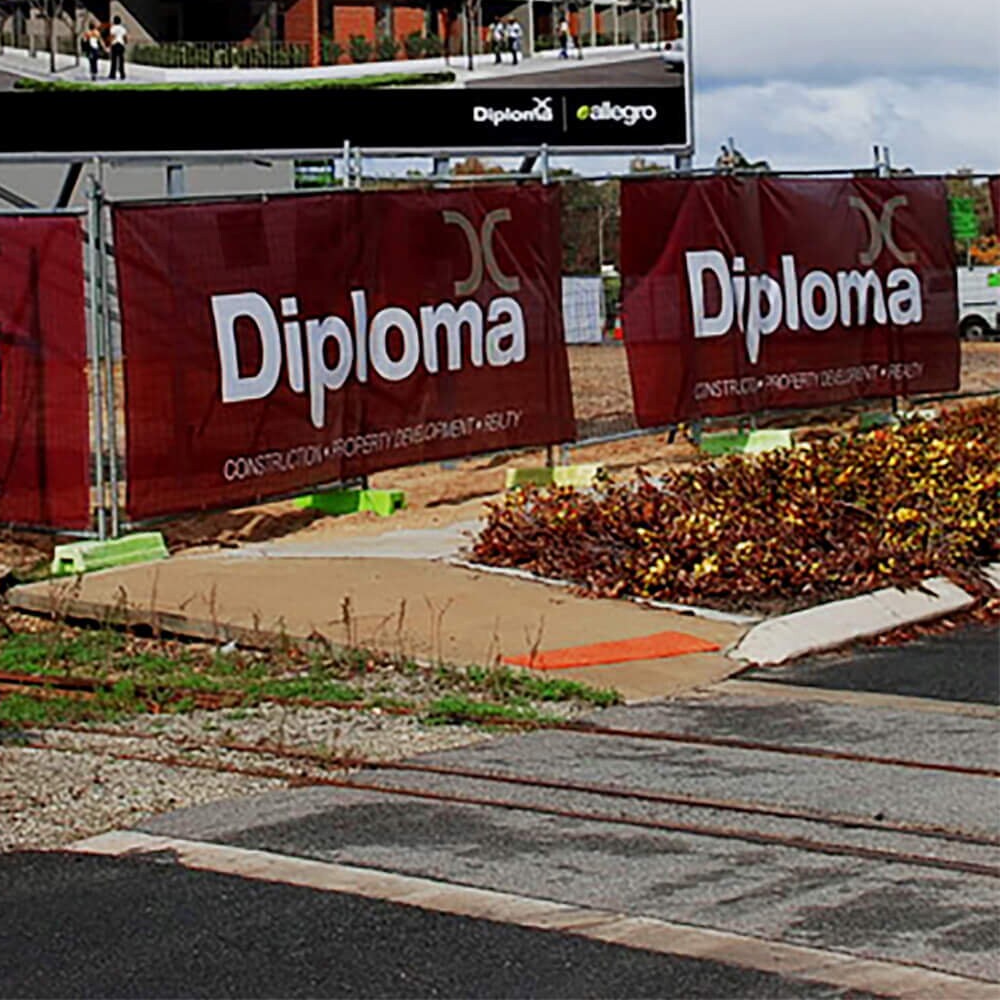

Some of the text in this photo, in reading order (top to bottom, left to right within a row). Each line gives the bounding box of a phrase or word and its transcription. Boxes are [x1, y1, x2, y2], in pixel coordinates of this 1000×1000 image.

[473, 104, 553, 126] Diploma
[590, 101, 657, 126] allegro
[685, 250, 923, 364] Diploma
[211, 289, 526, 429] Diploma
